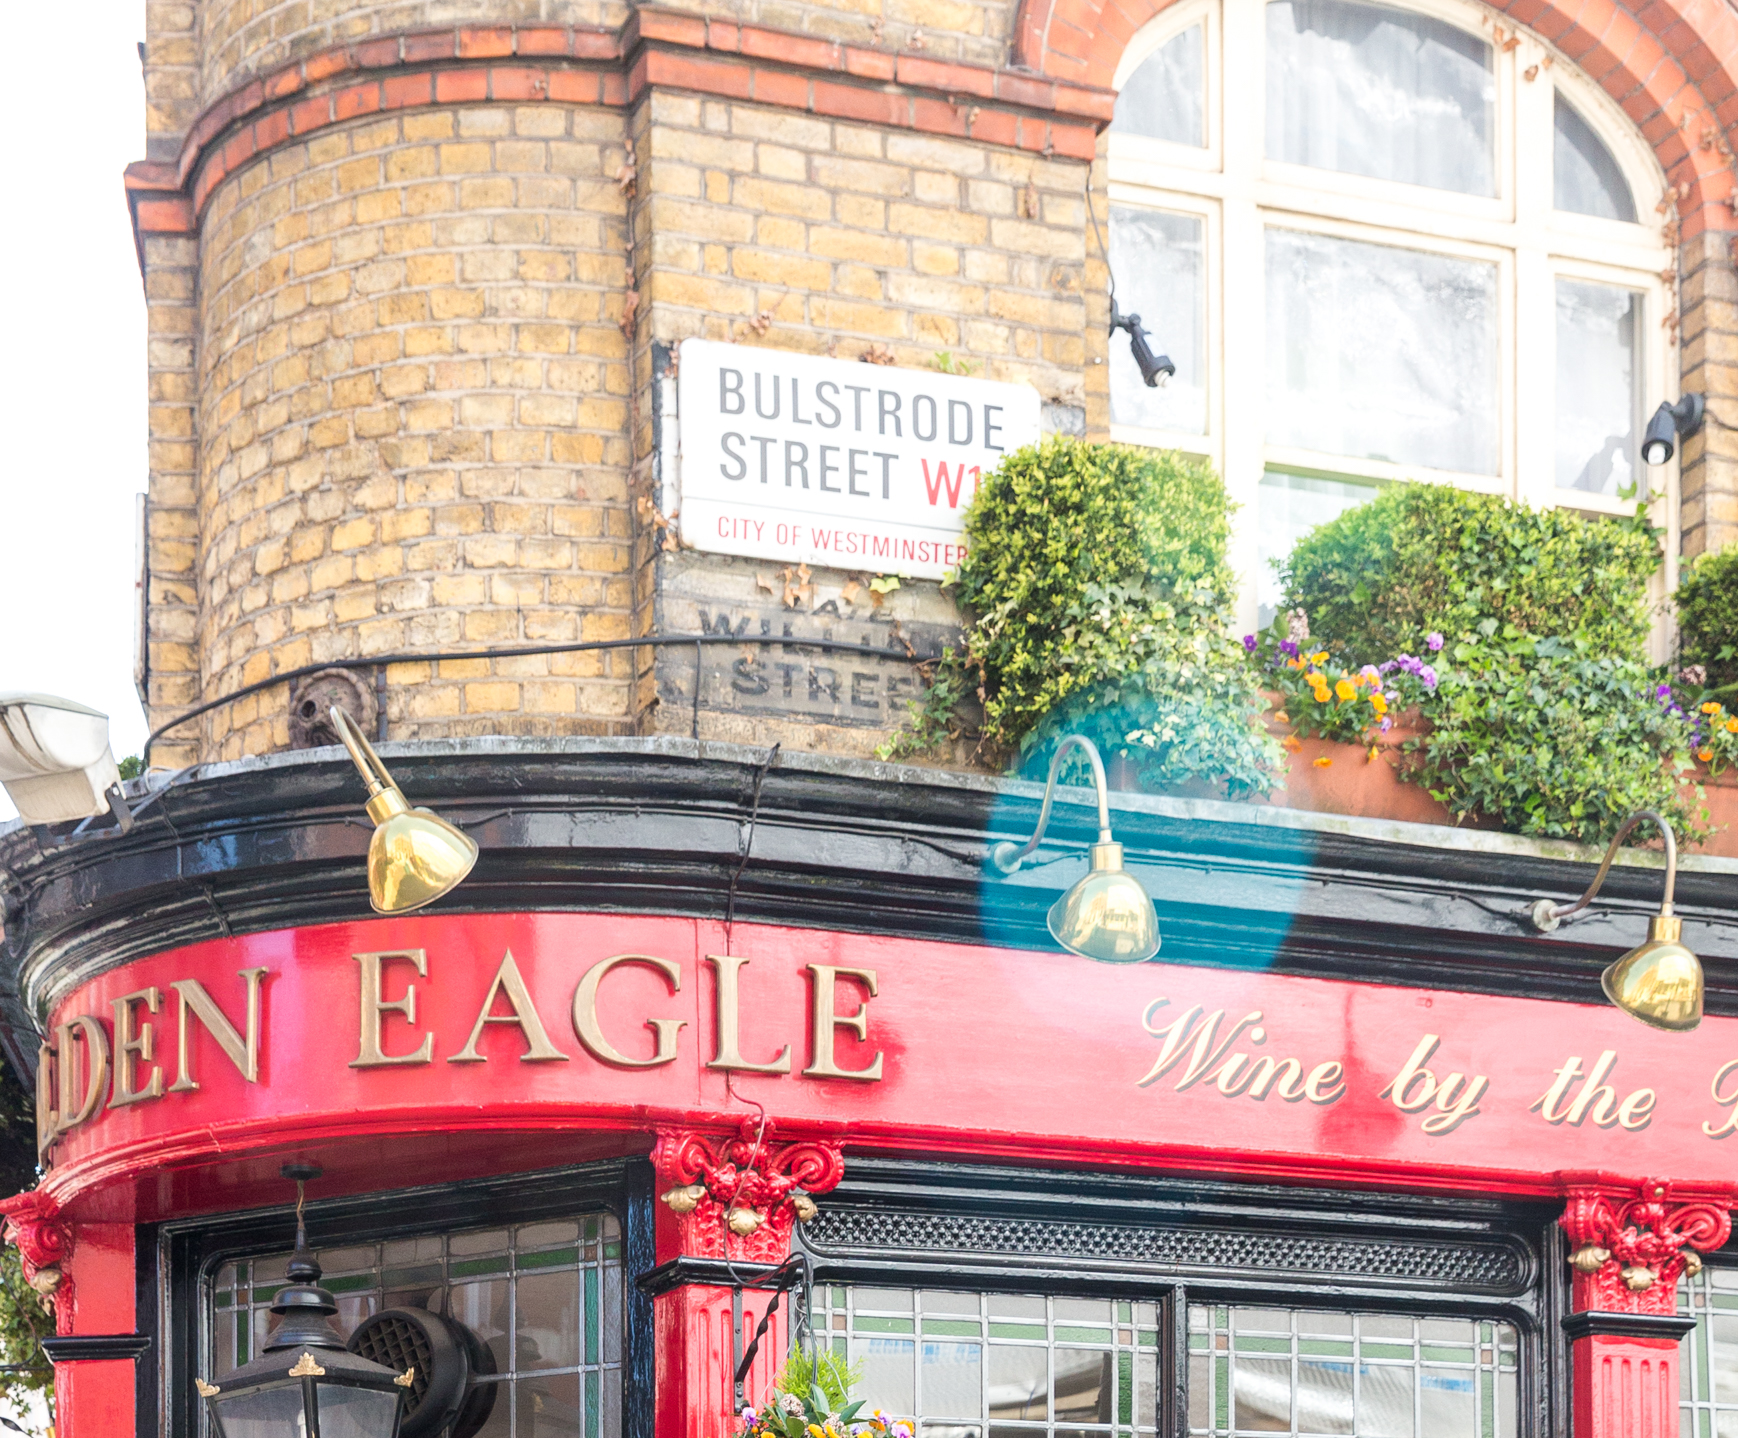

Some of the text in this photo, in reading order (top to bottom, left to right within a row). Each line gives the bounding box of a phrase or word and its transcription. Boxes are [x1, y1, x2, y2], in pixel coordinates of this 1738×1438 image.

[719, 367, 1005, 452] BULSTRODE
[719, 431, 981, 508] STREET W1
[717, 516, 969, 567] CITY OF WESTMINSTER
[731, 656, 915, 712] STREE
[36, 946, 885, 1172] LDEN EAGLE
[1136, 996, 1346, 1103] Wine
[1381, 1033, 1490, 1136] by
[1530, 1049, 1657, 1131] the
